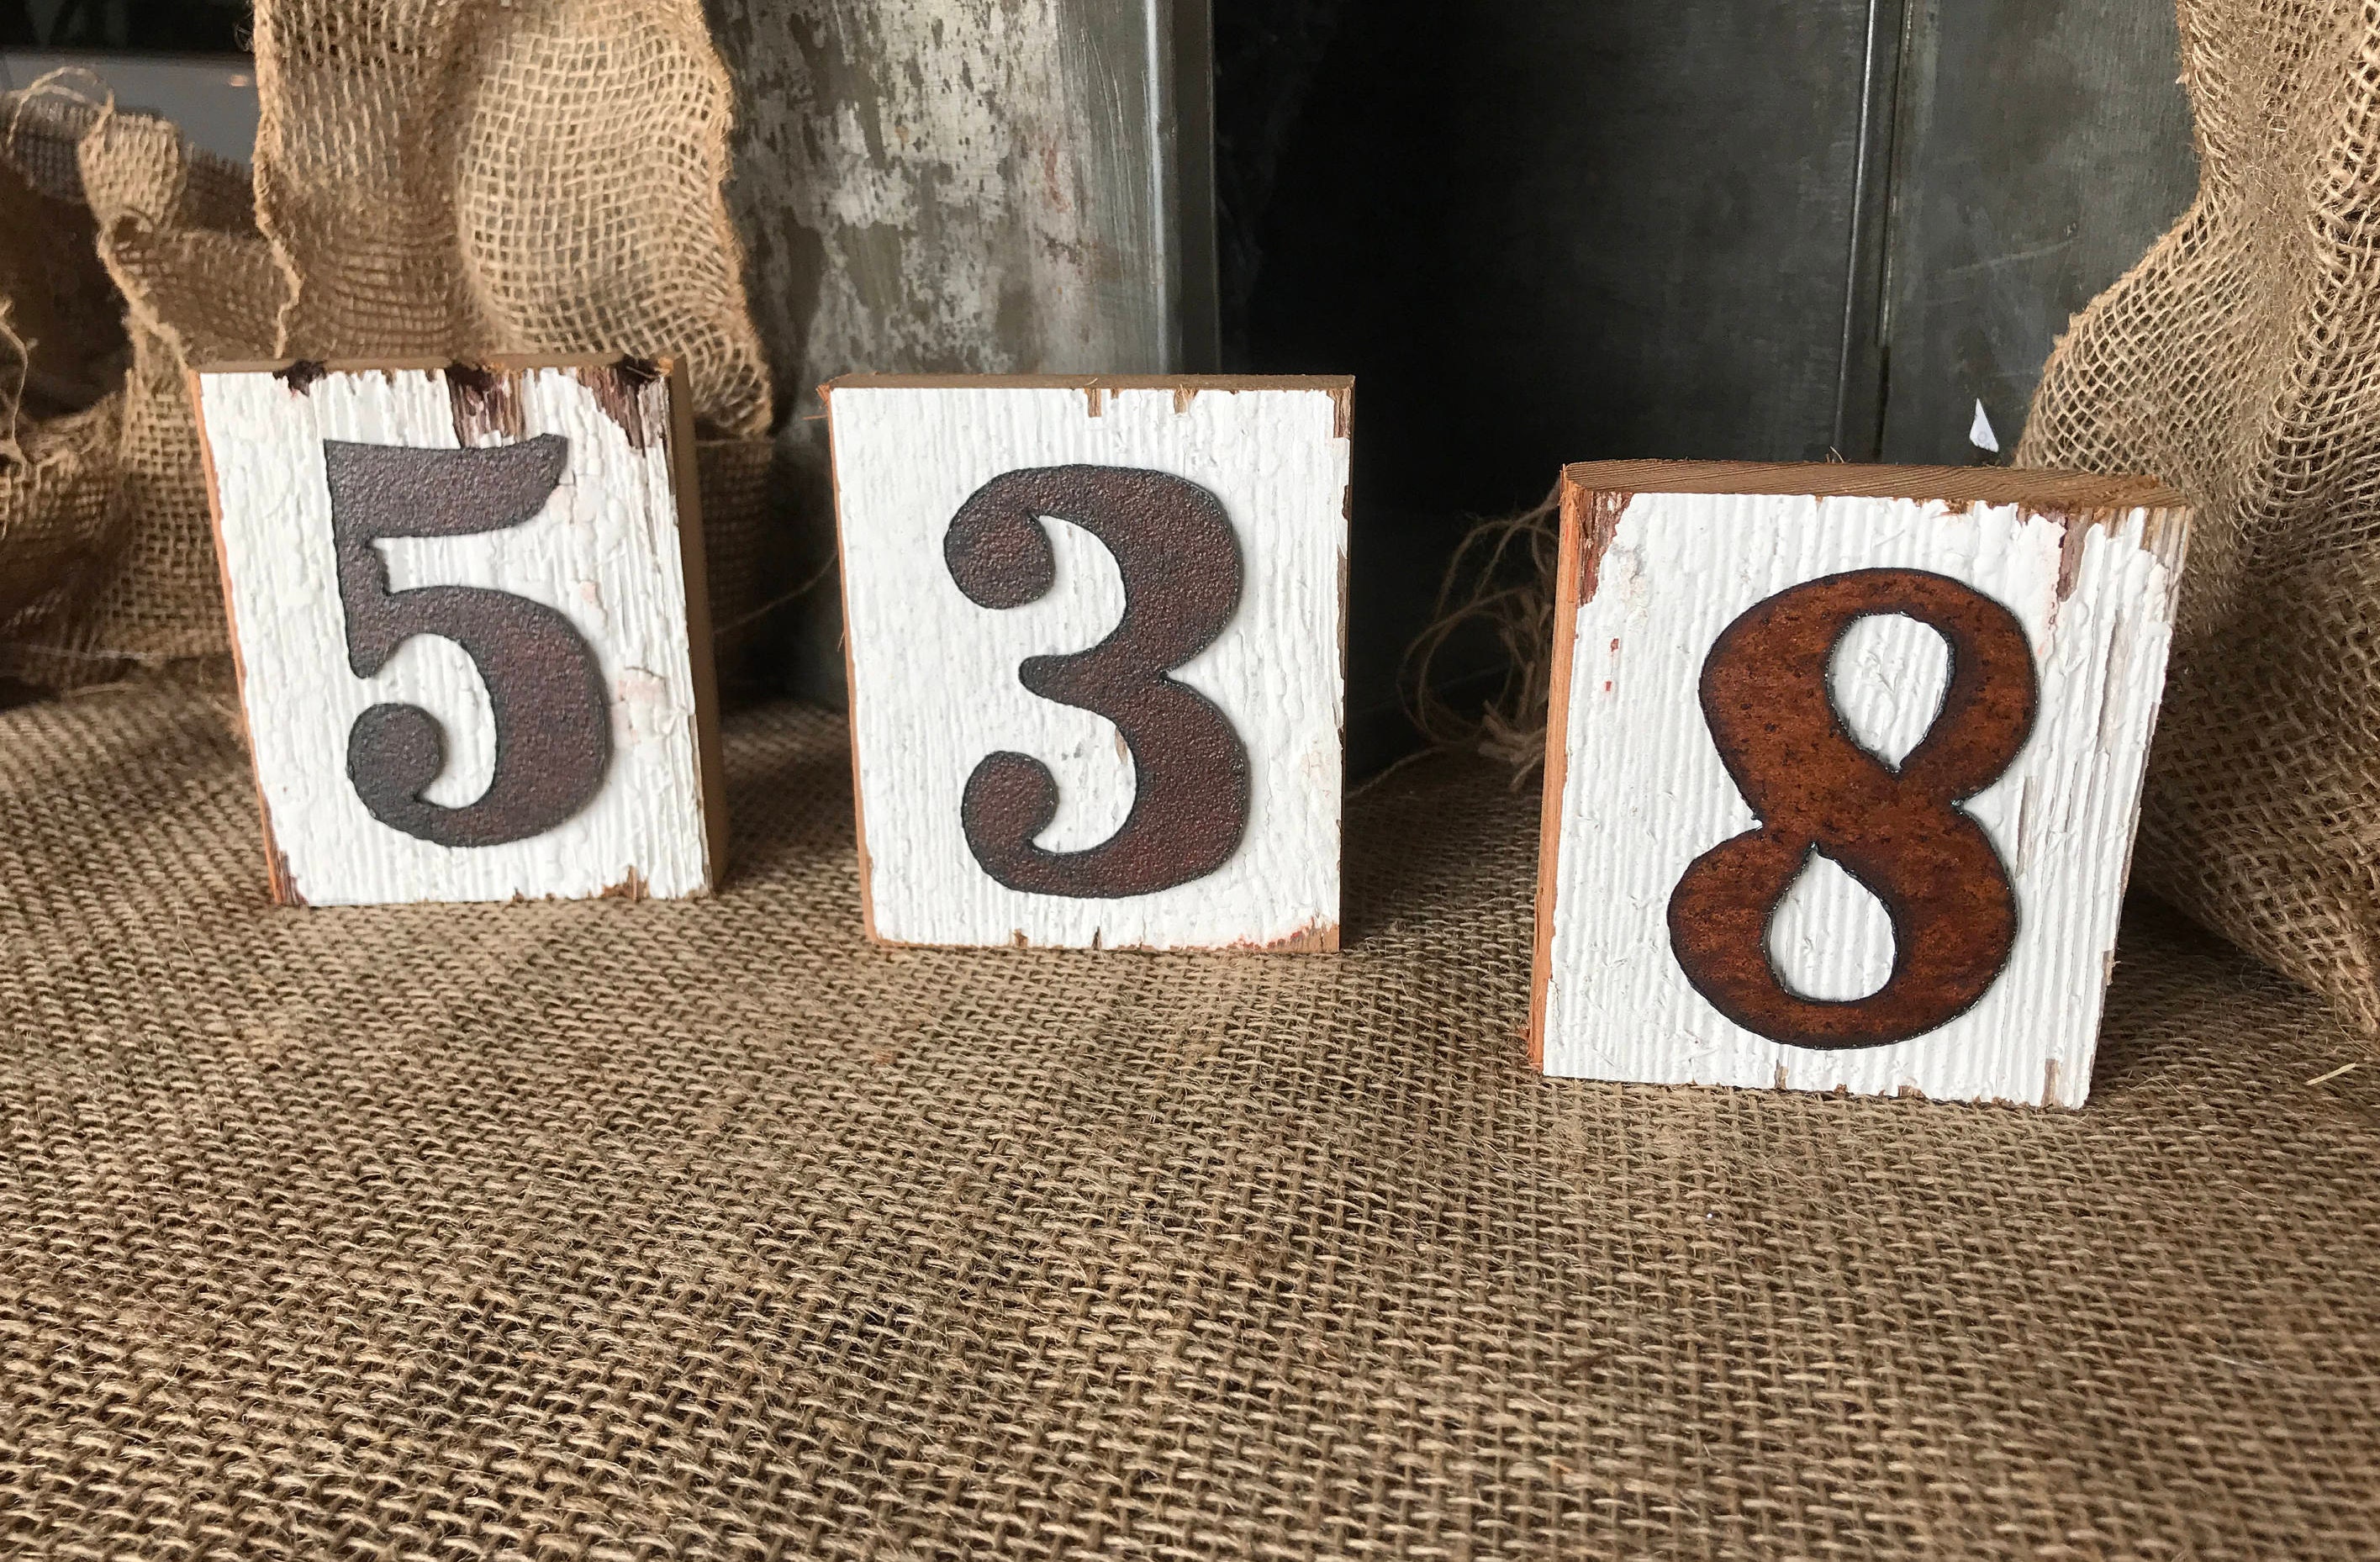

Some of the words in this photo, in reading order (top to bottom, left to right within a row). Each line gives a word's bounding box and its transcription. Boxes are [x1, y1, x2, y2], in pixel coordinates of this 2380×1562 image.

[323, 434, 610, 847] 5
[942, 464, 1248, 899] 3
[1667, 568, 2037, 1049] 8
